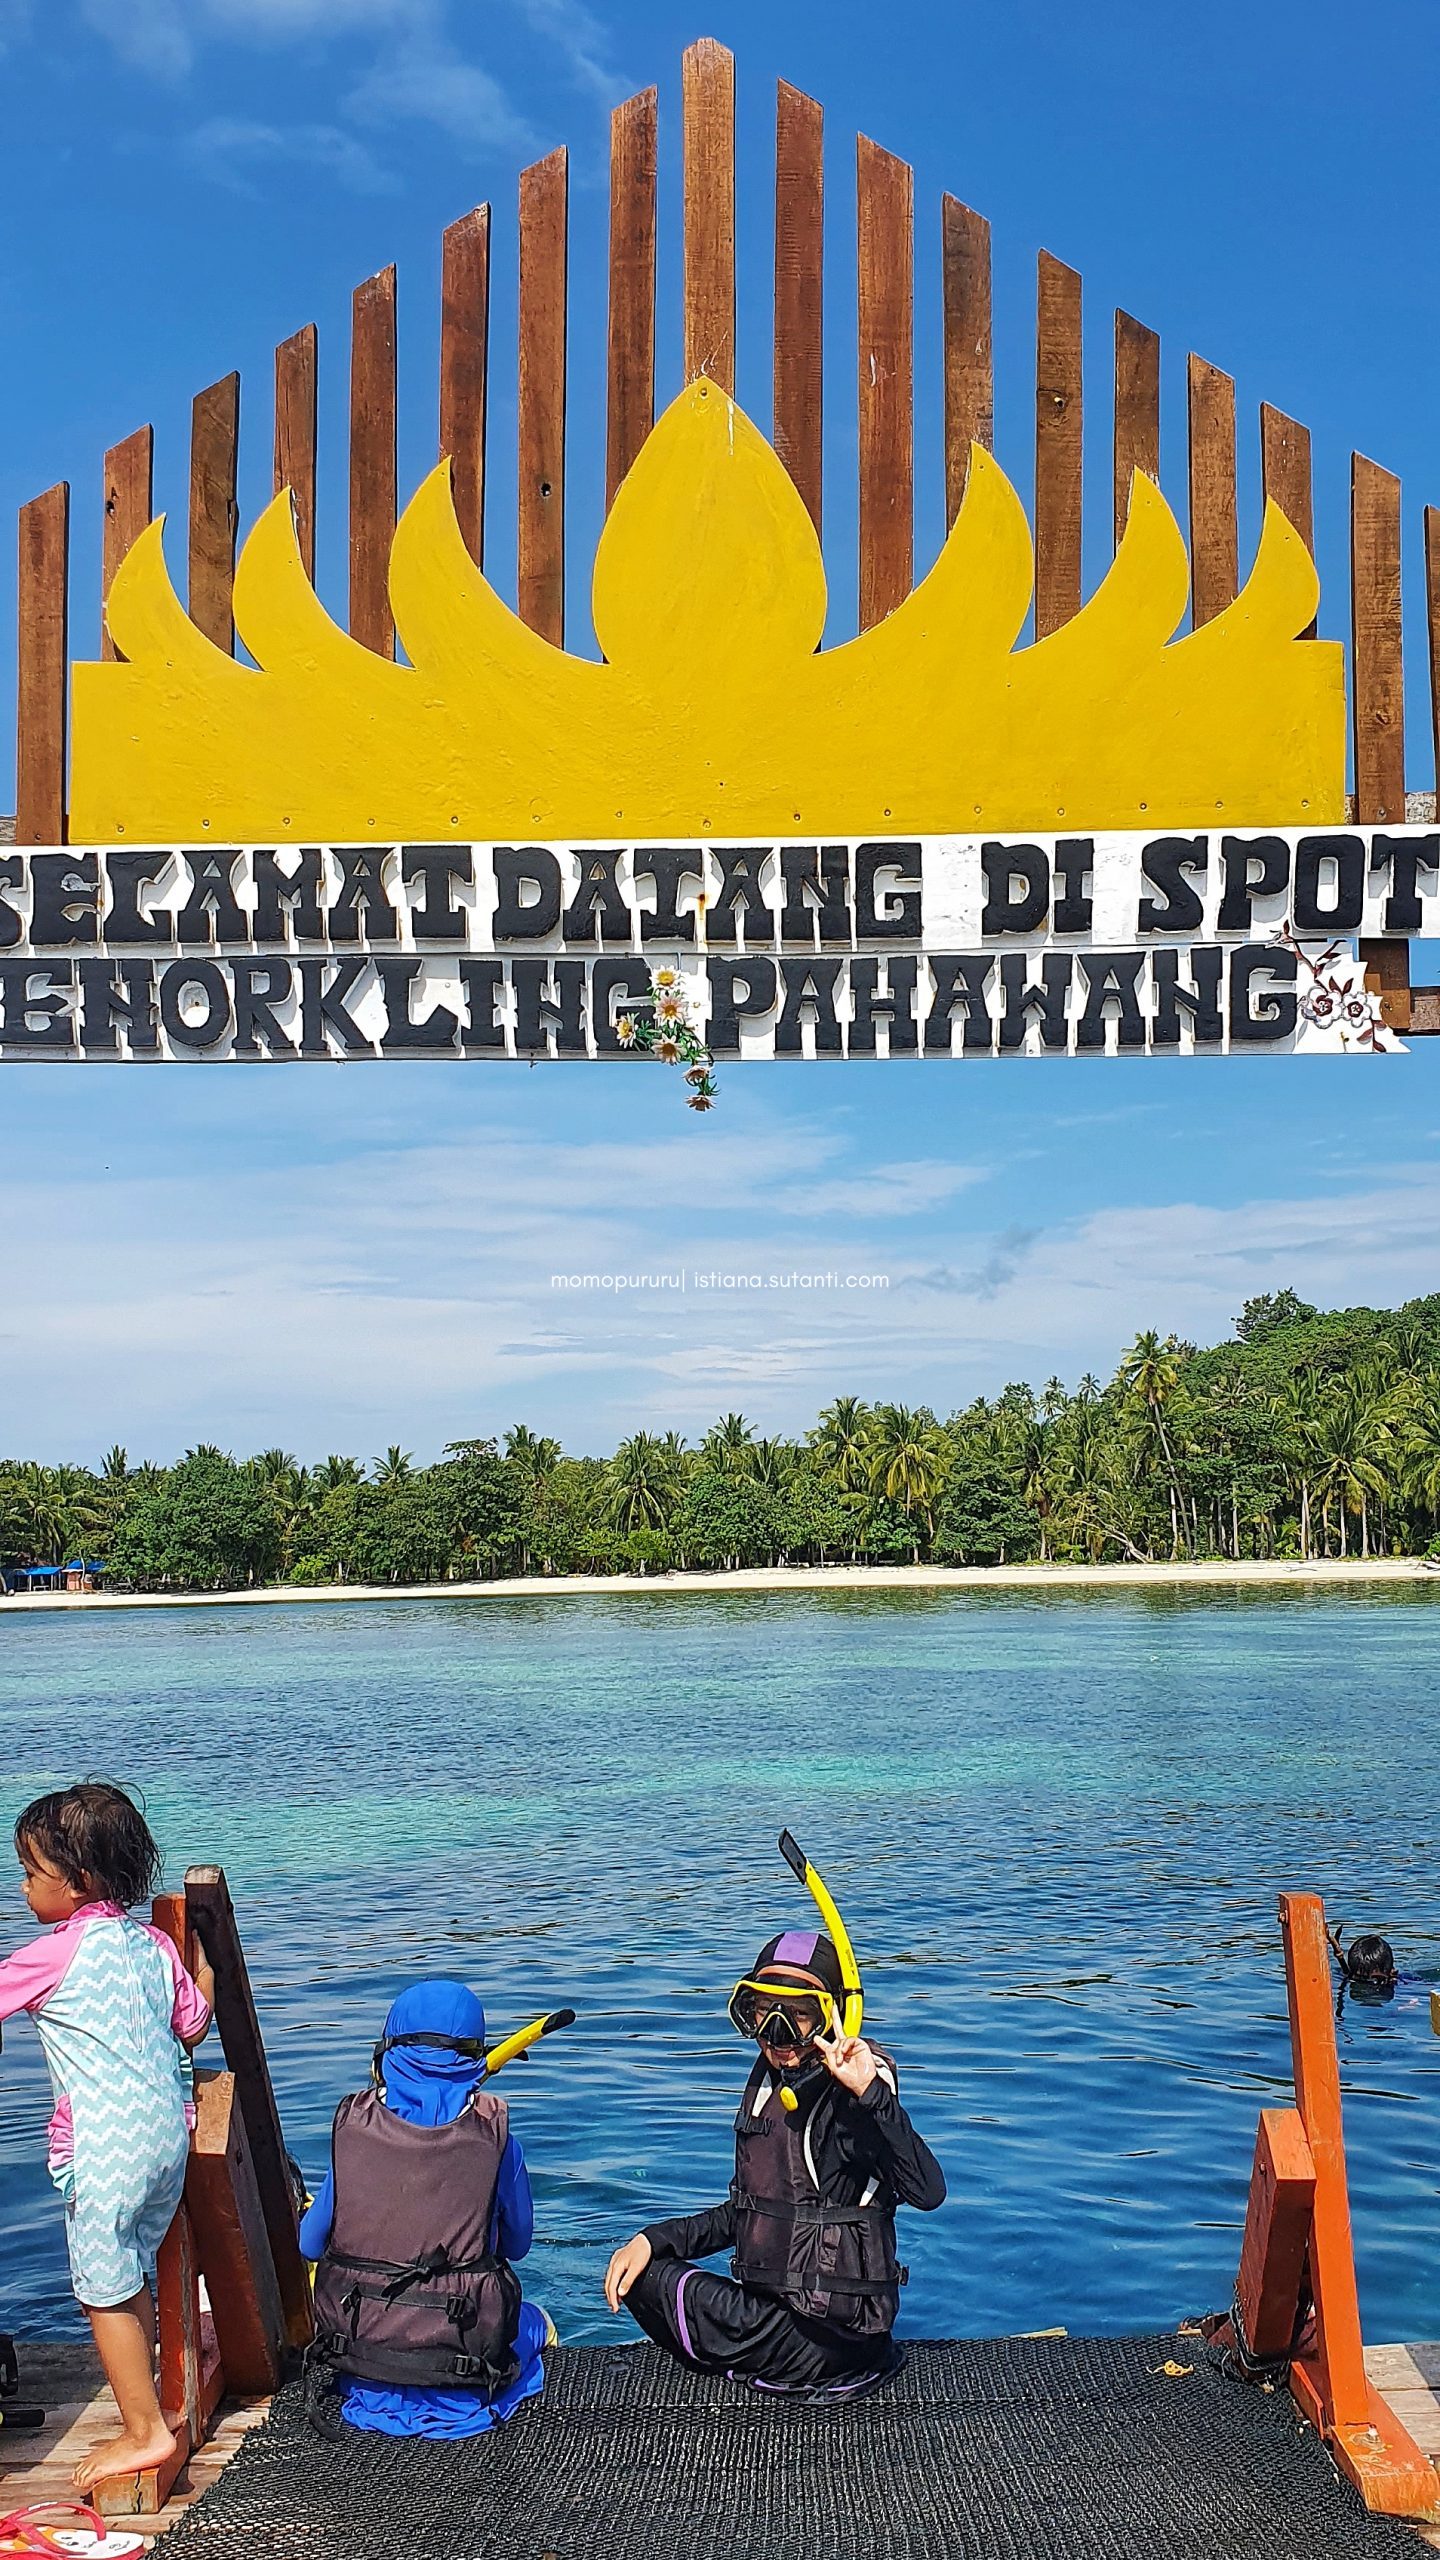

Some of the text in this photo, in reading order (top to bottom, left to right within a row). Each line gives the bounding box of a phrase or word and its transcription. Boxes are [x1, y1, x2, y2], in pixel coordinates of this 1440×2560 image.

[493, 842, 922, 941] DATANG
[981, 839, 1094, 934] DI
[1138, 833, 1440, 932] SPOT
[706, 945, 1298, 1050] PAHAWANG
